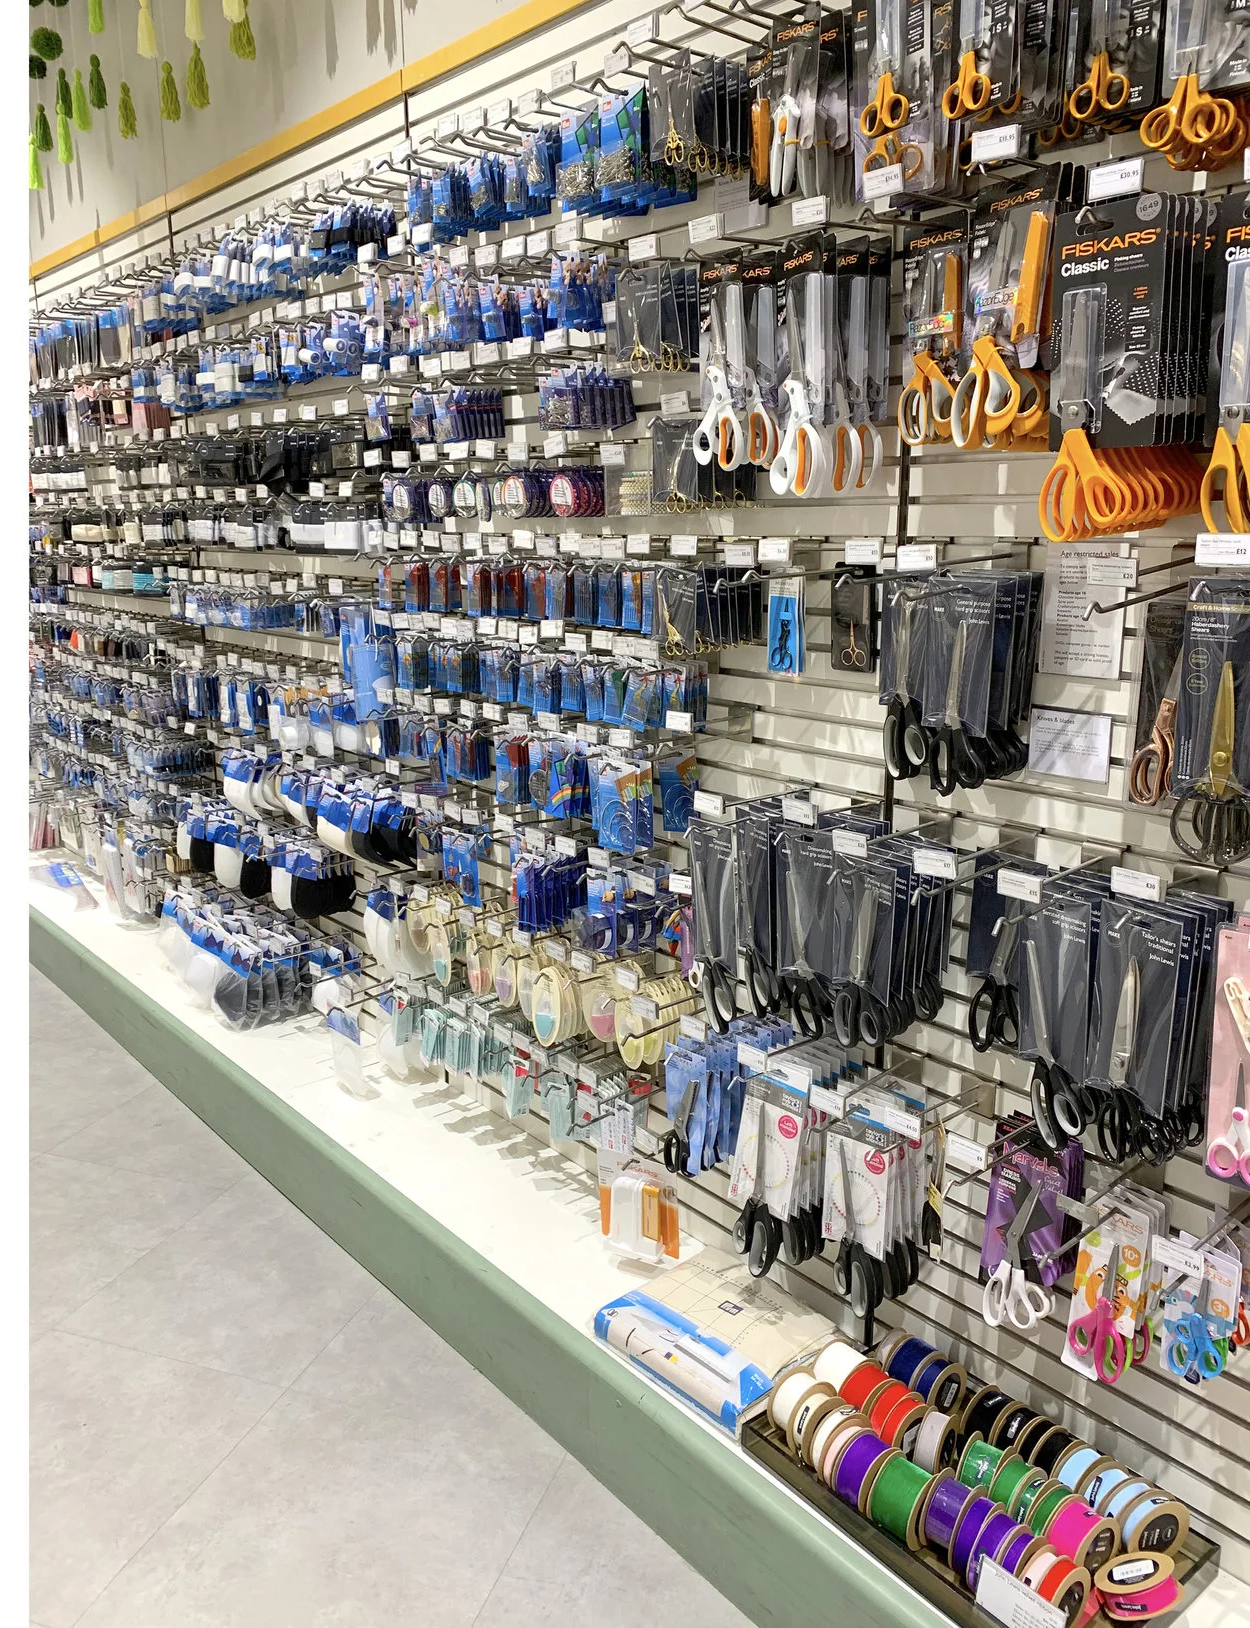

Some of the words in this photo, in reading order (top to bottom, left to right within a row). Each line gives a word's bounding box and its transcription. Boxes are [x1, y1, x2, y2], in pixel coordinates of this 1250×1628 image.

[777, 21, 815, 42] FISKARS
[749, 52, 772, 75] FISKAR
[1120, 170, 1139, 179] £30.95
[990, 189, 1042, 213] FISKARS
[1140, 201, 1159, 212] 1649
[910, 230, 962, 250] FISKARS
[1062, 229, 1158, 260] FISKARS
[784, 251, 813, 271] FISKARS
[1061, 258, 1110, 277] Classic
[703, 265, 738, 280] FISKARS
[1060, 550, 1072, 558] Age
[1073, 550, 1103, 558] restricted
[1104, 550, 1119, 558] sales
[1192, 622, 1230, 630] Haberdashery
[1037, 714, 1054, 722] Knives
[1060, 914, 1086, 928] dressmaking
[1070, 924, 1086, 933] scissors
[1108, 930, 1120, 939] MAKE
[1072, 936, 1086, 944] Lewis
[1142, 931, 1159, 942] Tailor's
[1160, 938, 1176, 948] shears
[1148, 941, 1174, 954] traditional
[1149, 954, 1161, 962] John
[1161, 958, 1175, 967] Lewis
[1123, 1248, 1139, 1260] 10+
